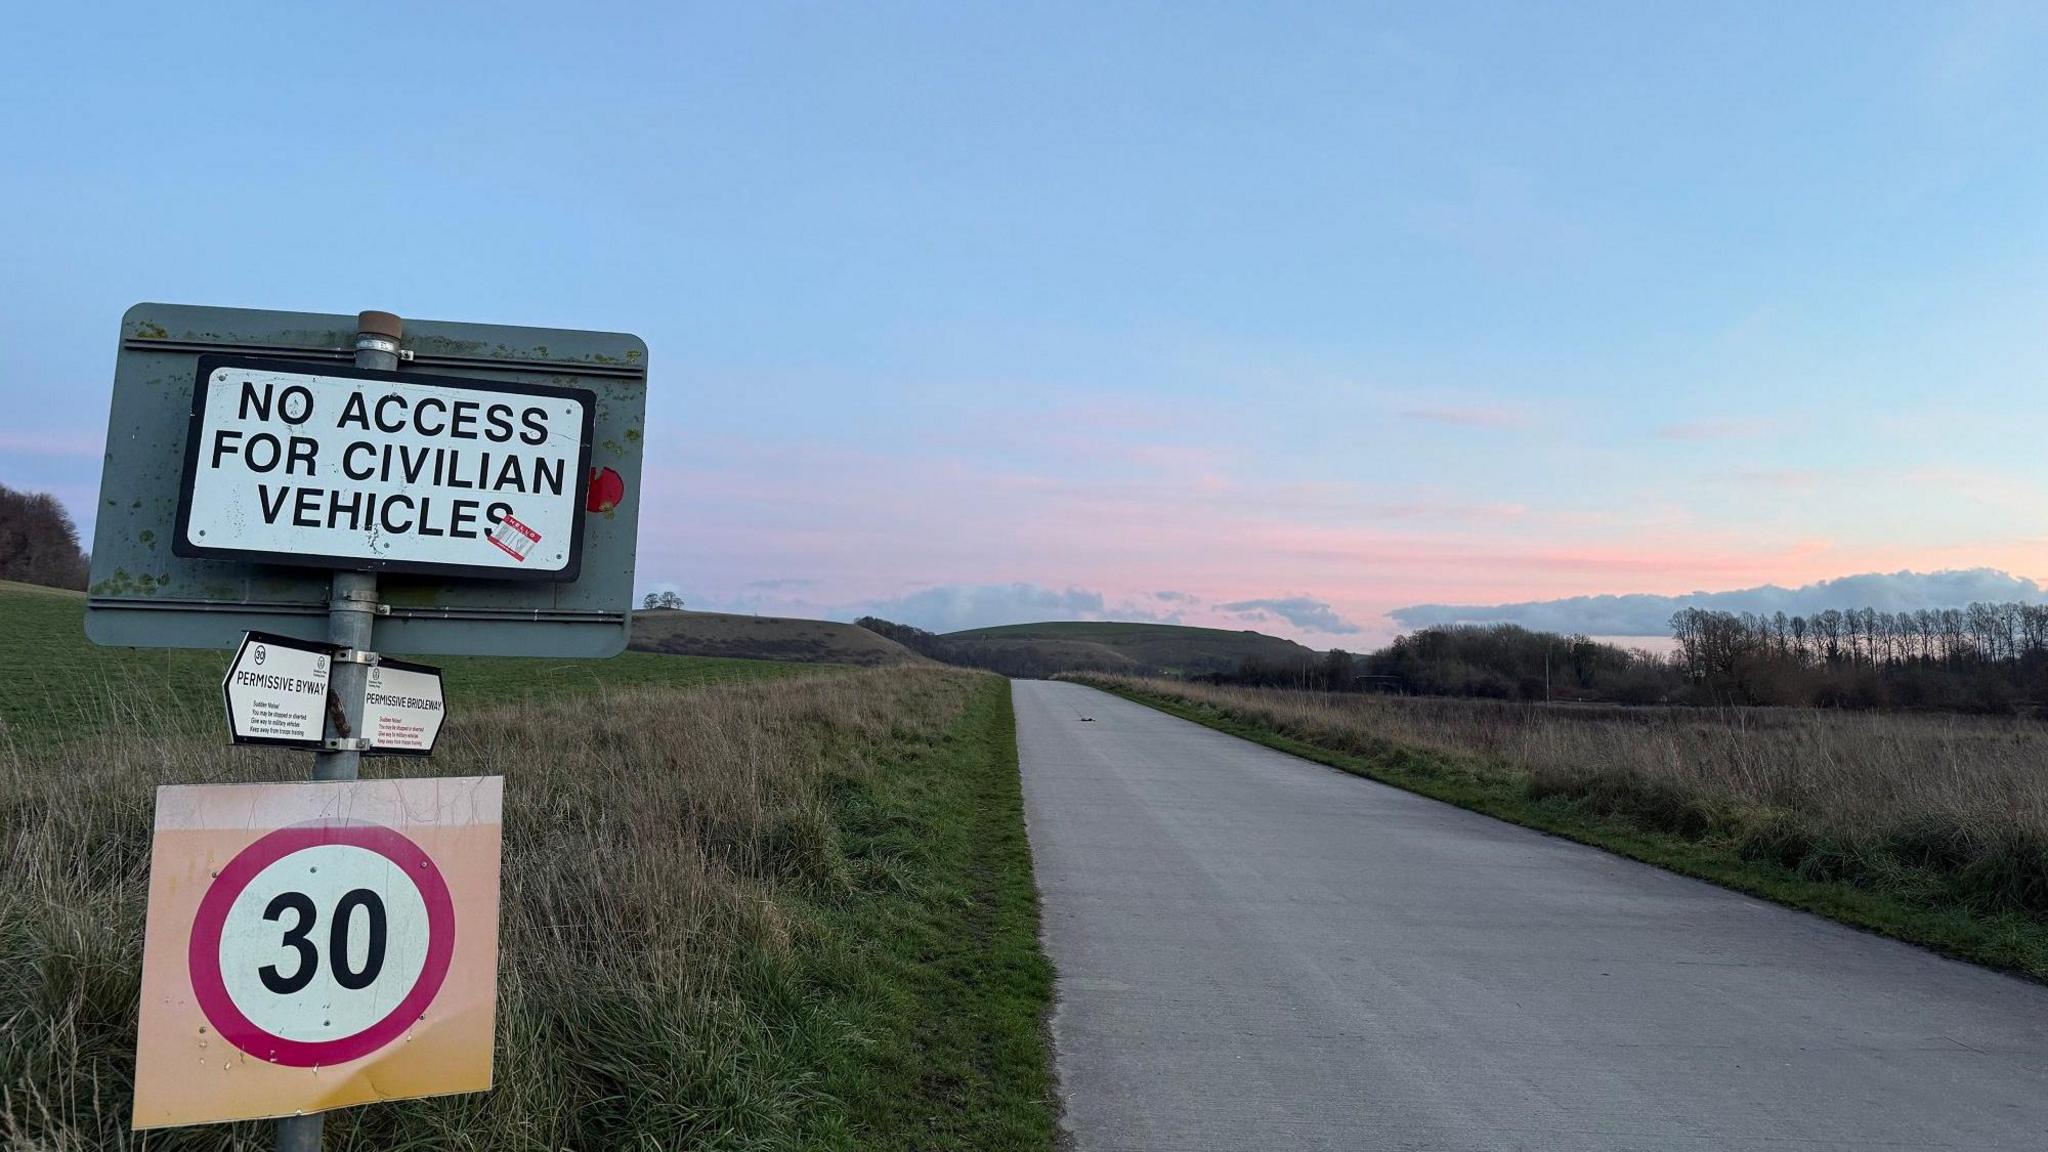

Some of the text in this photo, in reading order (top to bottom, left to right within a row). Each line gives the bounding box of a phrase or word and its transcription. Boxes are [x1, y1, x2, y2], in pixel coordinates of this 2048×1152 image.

[238, 381, 550, 446] NO ACCESS
[210, 429, 566, 497] FOR CIVILIAN
[257, 483, 515, 540] VEHICLES
[509, 519, 536, 538] HELLO
[237, 671, 326, 696] PERMISSIVE BYWAY
[366, 693, 442, 711] PERMISSIVE BRIDLEWAY
[258, 887, 388, 995] 30
